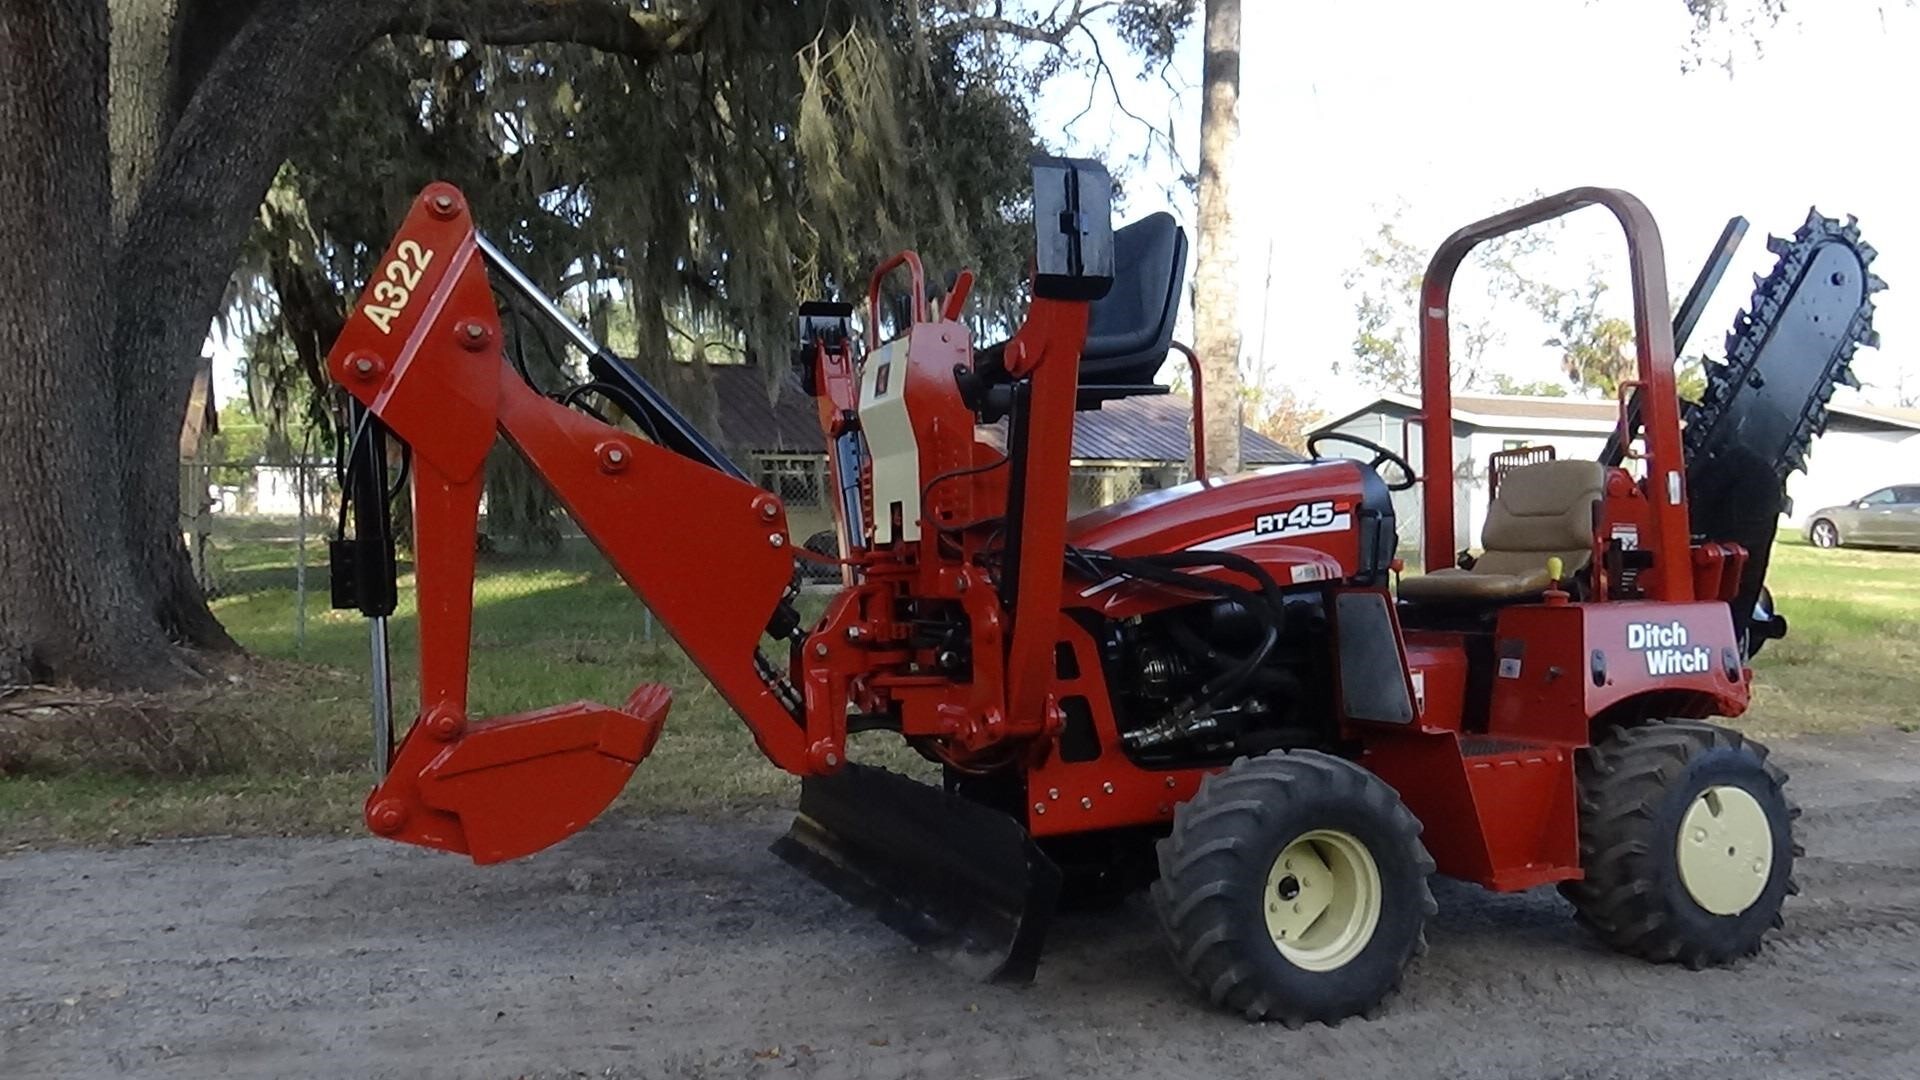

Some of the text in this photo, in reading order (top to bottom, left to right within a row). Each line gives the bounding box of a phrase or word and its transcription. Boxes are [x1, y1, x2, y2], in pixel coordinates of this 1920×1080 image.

[363, 239, 434, 335] A322
[1256, 501, 1334, 534] RT45
[1627, 622, 1687, 649] Ditch
[1646, 647, 1709, 675] Witch
